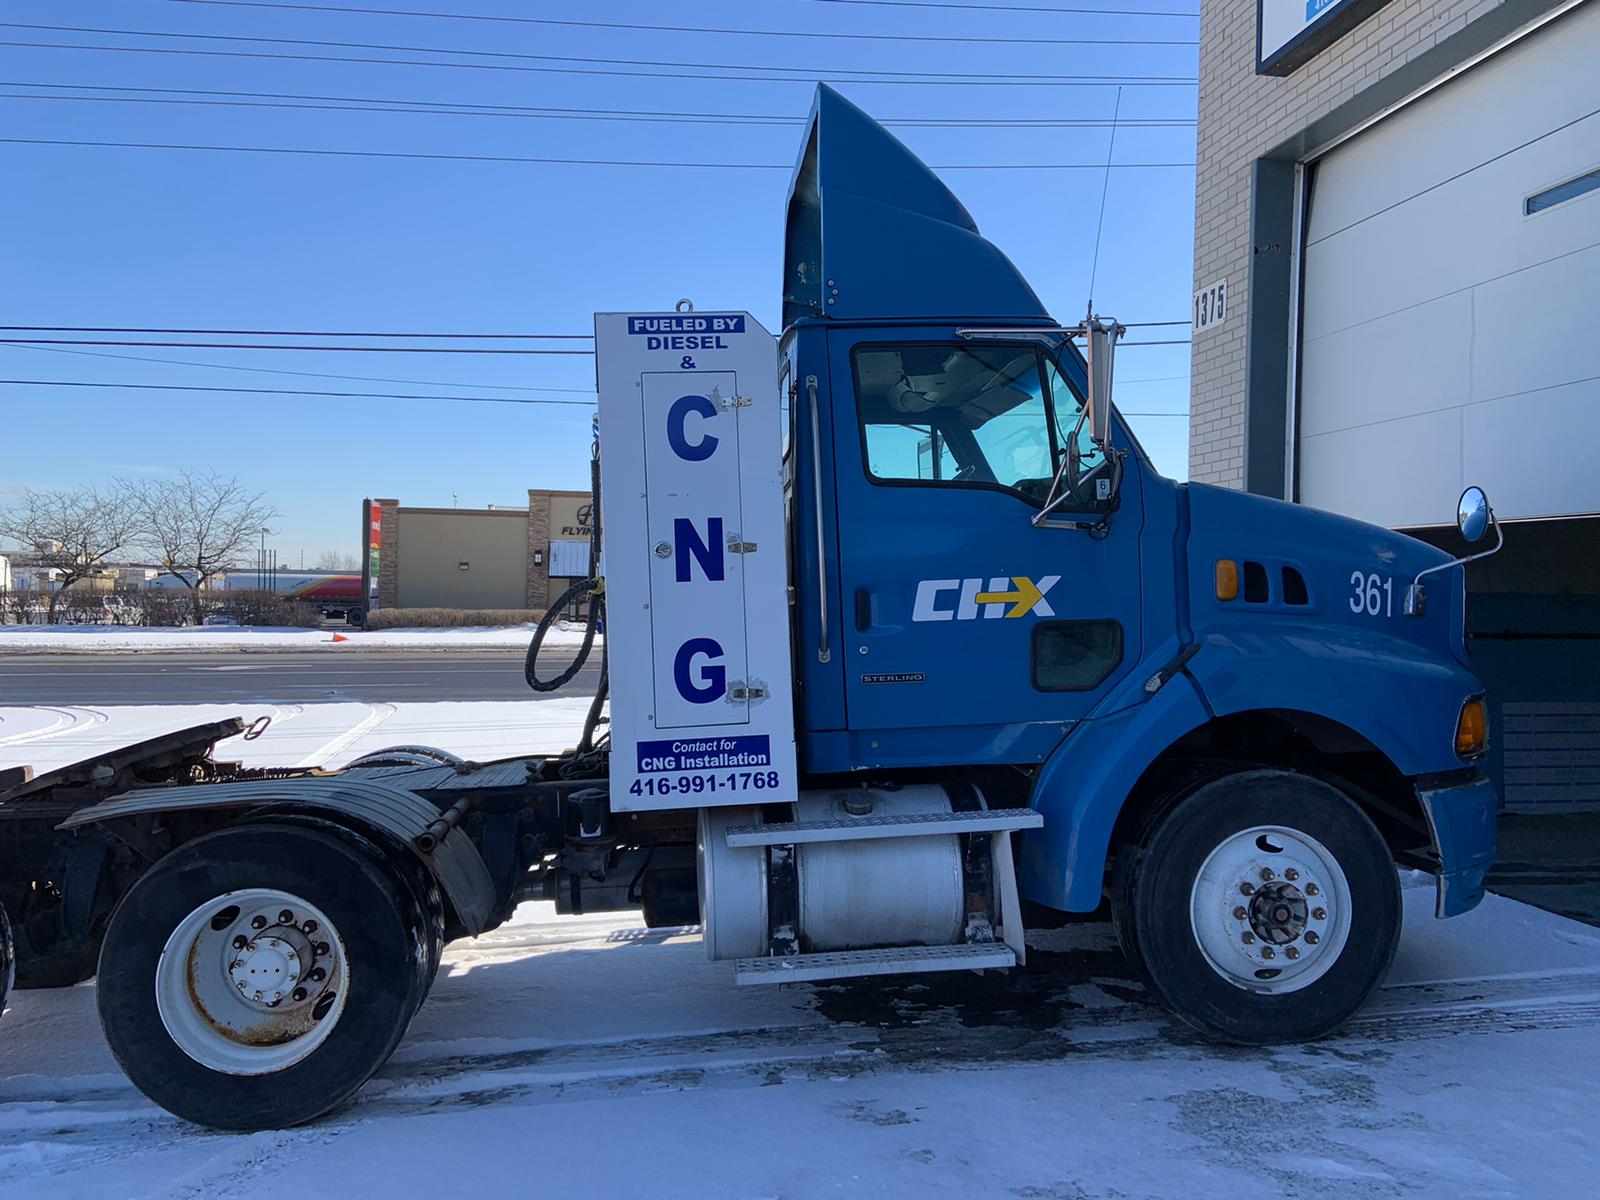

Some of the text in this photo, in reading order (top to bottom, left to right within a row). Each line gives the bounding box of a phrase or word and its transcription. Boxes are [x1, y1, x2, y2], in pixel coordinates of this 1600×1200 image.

[1195, 284, 1224, 329] 1375
[633, 318, 739, 332] FUELED BY
[647, 336, 728, 350] DIESEL
[680, 355, 696, 370] &
[1100, 480, 1106, 490] 6
[561, 526, 603, 536] FLYIN
[1349, 570, 1392, 618] 361
[863, 674, 922, 682] STERLING
[672, 739, 737, 753] Contact for
[641, 753, 767, 771] CNG Installation
[629, 771, 780, 797] 416-991-1768
